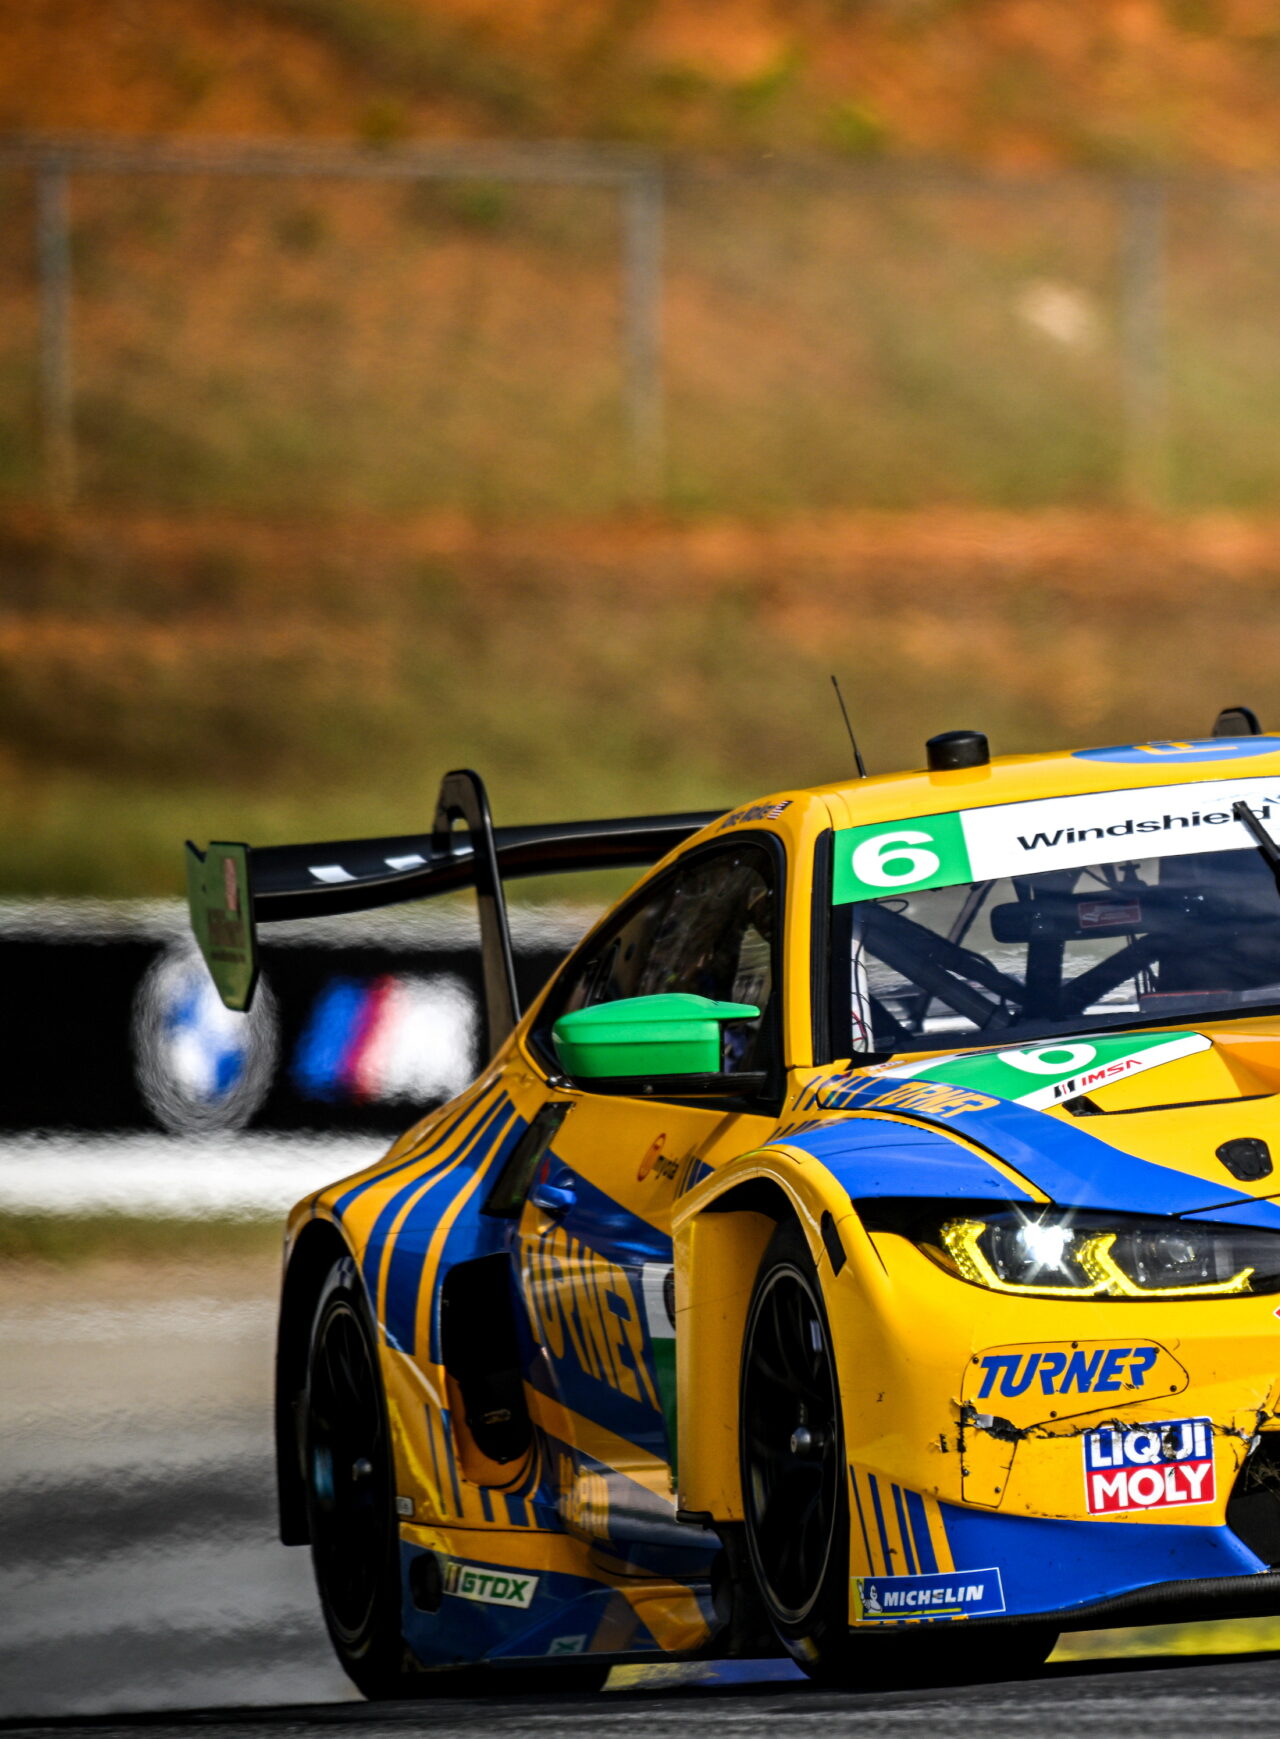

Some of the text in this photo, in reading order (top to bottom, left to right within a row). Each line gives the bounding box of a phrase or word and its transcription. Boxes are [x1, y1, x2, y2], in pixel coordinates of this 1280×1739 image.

[852, 831, 940, 887] 6
[997, 1042, 1097, 1075] 6
[1081, 1059, 1143, 1087] IMSA
[862, 1081, 1001, 1119] TURNER
[977, 1346, 1158, 1399] TURNER
[1090, 1422, 1206, 1468] LIQUI
[1092, 1463, 1211, 1510] MOLY
[461, 1571, 530, 1602] GTDX
[883, 1584, 984, 1607] MICHELIN
